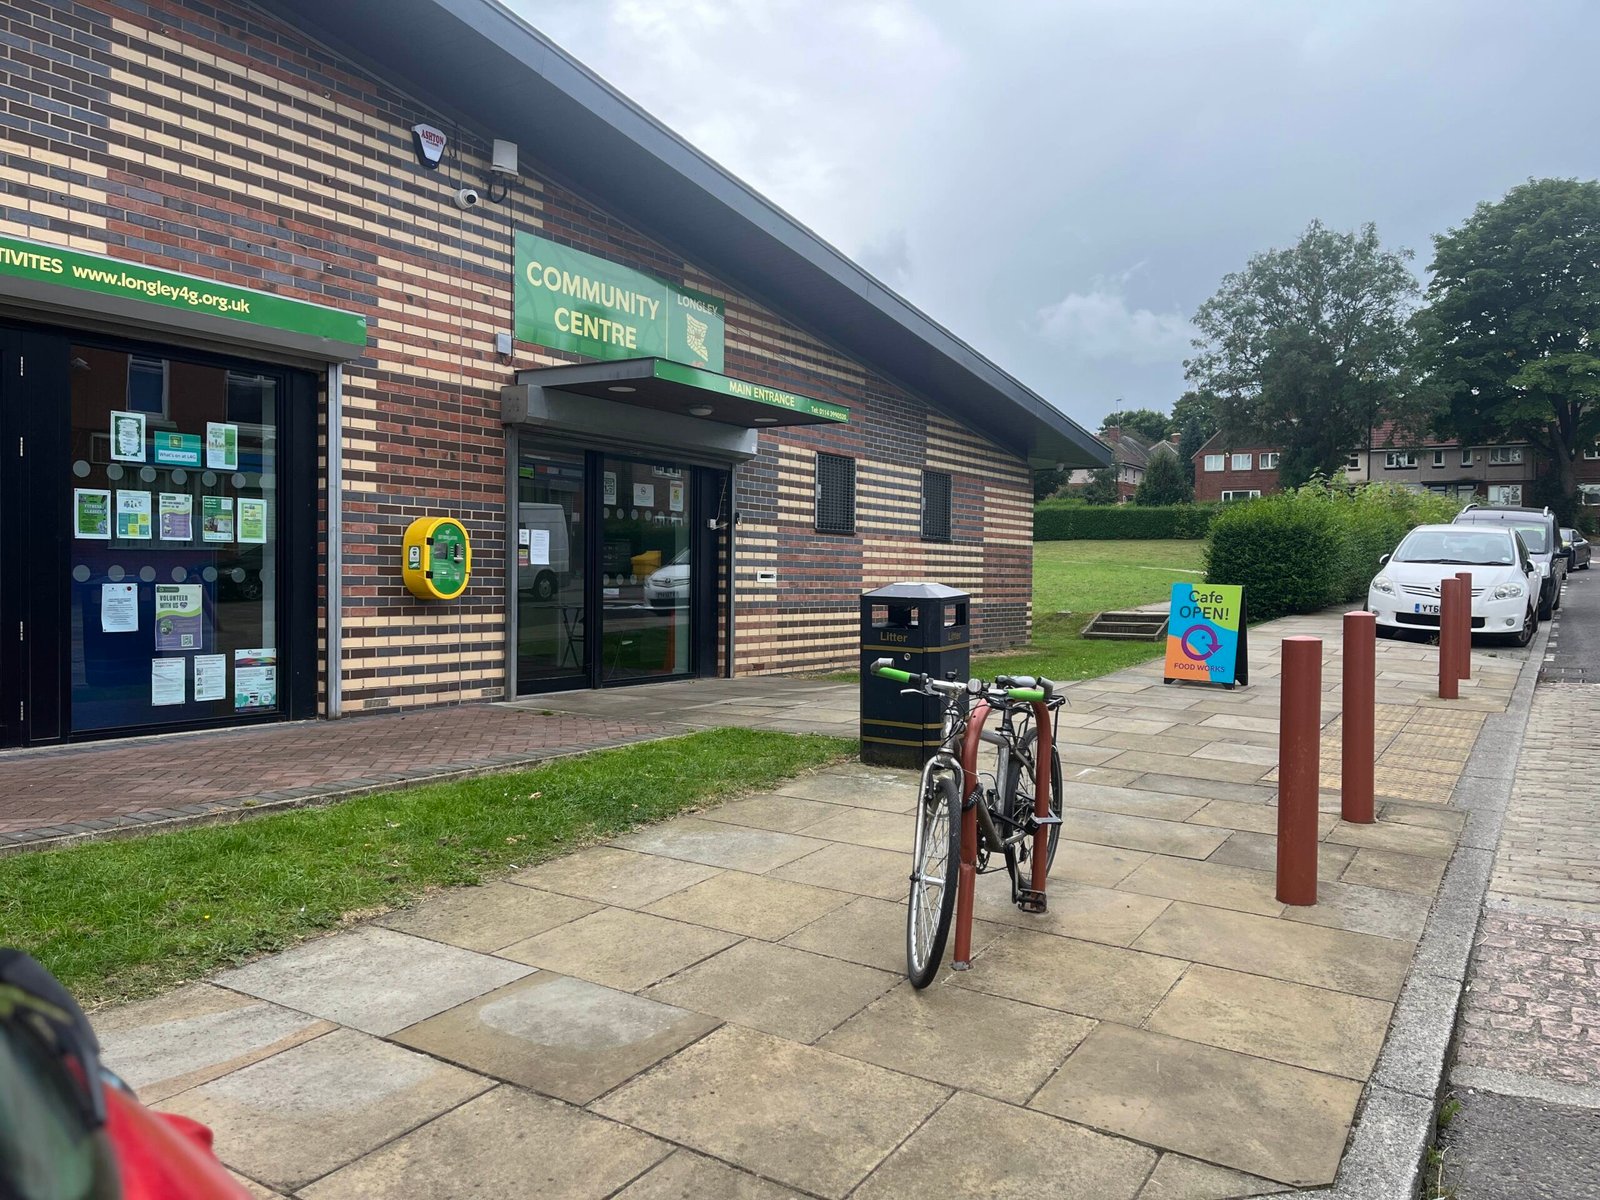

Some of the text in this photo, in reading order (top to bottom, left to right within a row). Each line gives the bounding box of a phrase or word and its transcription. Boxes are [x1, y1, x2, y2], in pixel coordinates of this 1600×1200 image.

[421, 129, 444, 145] ASHTON
[72, 264, 250, 314] www.longley4g.org.uk
[526, 261, 660, 320] COMMUNITY
[677, 294, 718, 316] LONGLEY
[554, 307, 637, 350] CENTRE
[729, 381, 795, 407] MAIN ENTRANCE
[1189, 590, 1223, 604] Cafe
[1180, 605, 1229, 621] OPEN!
[1422, 604, 1441, 613] YT6
[880, 631, 908, 643] Litter
[1197, 664, 1225, 672] WORKS
